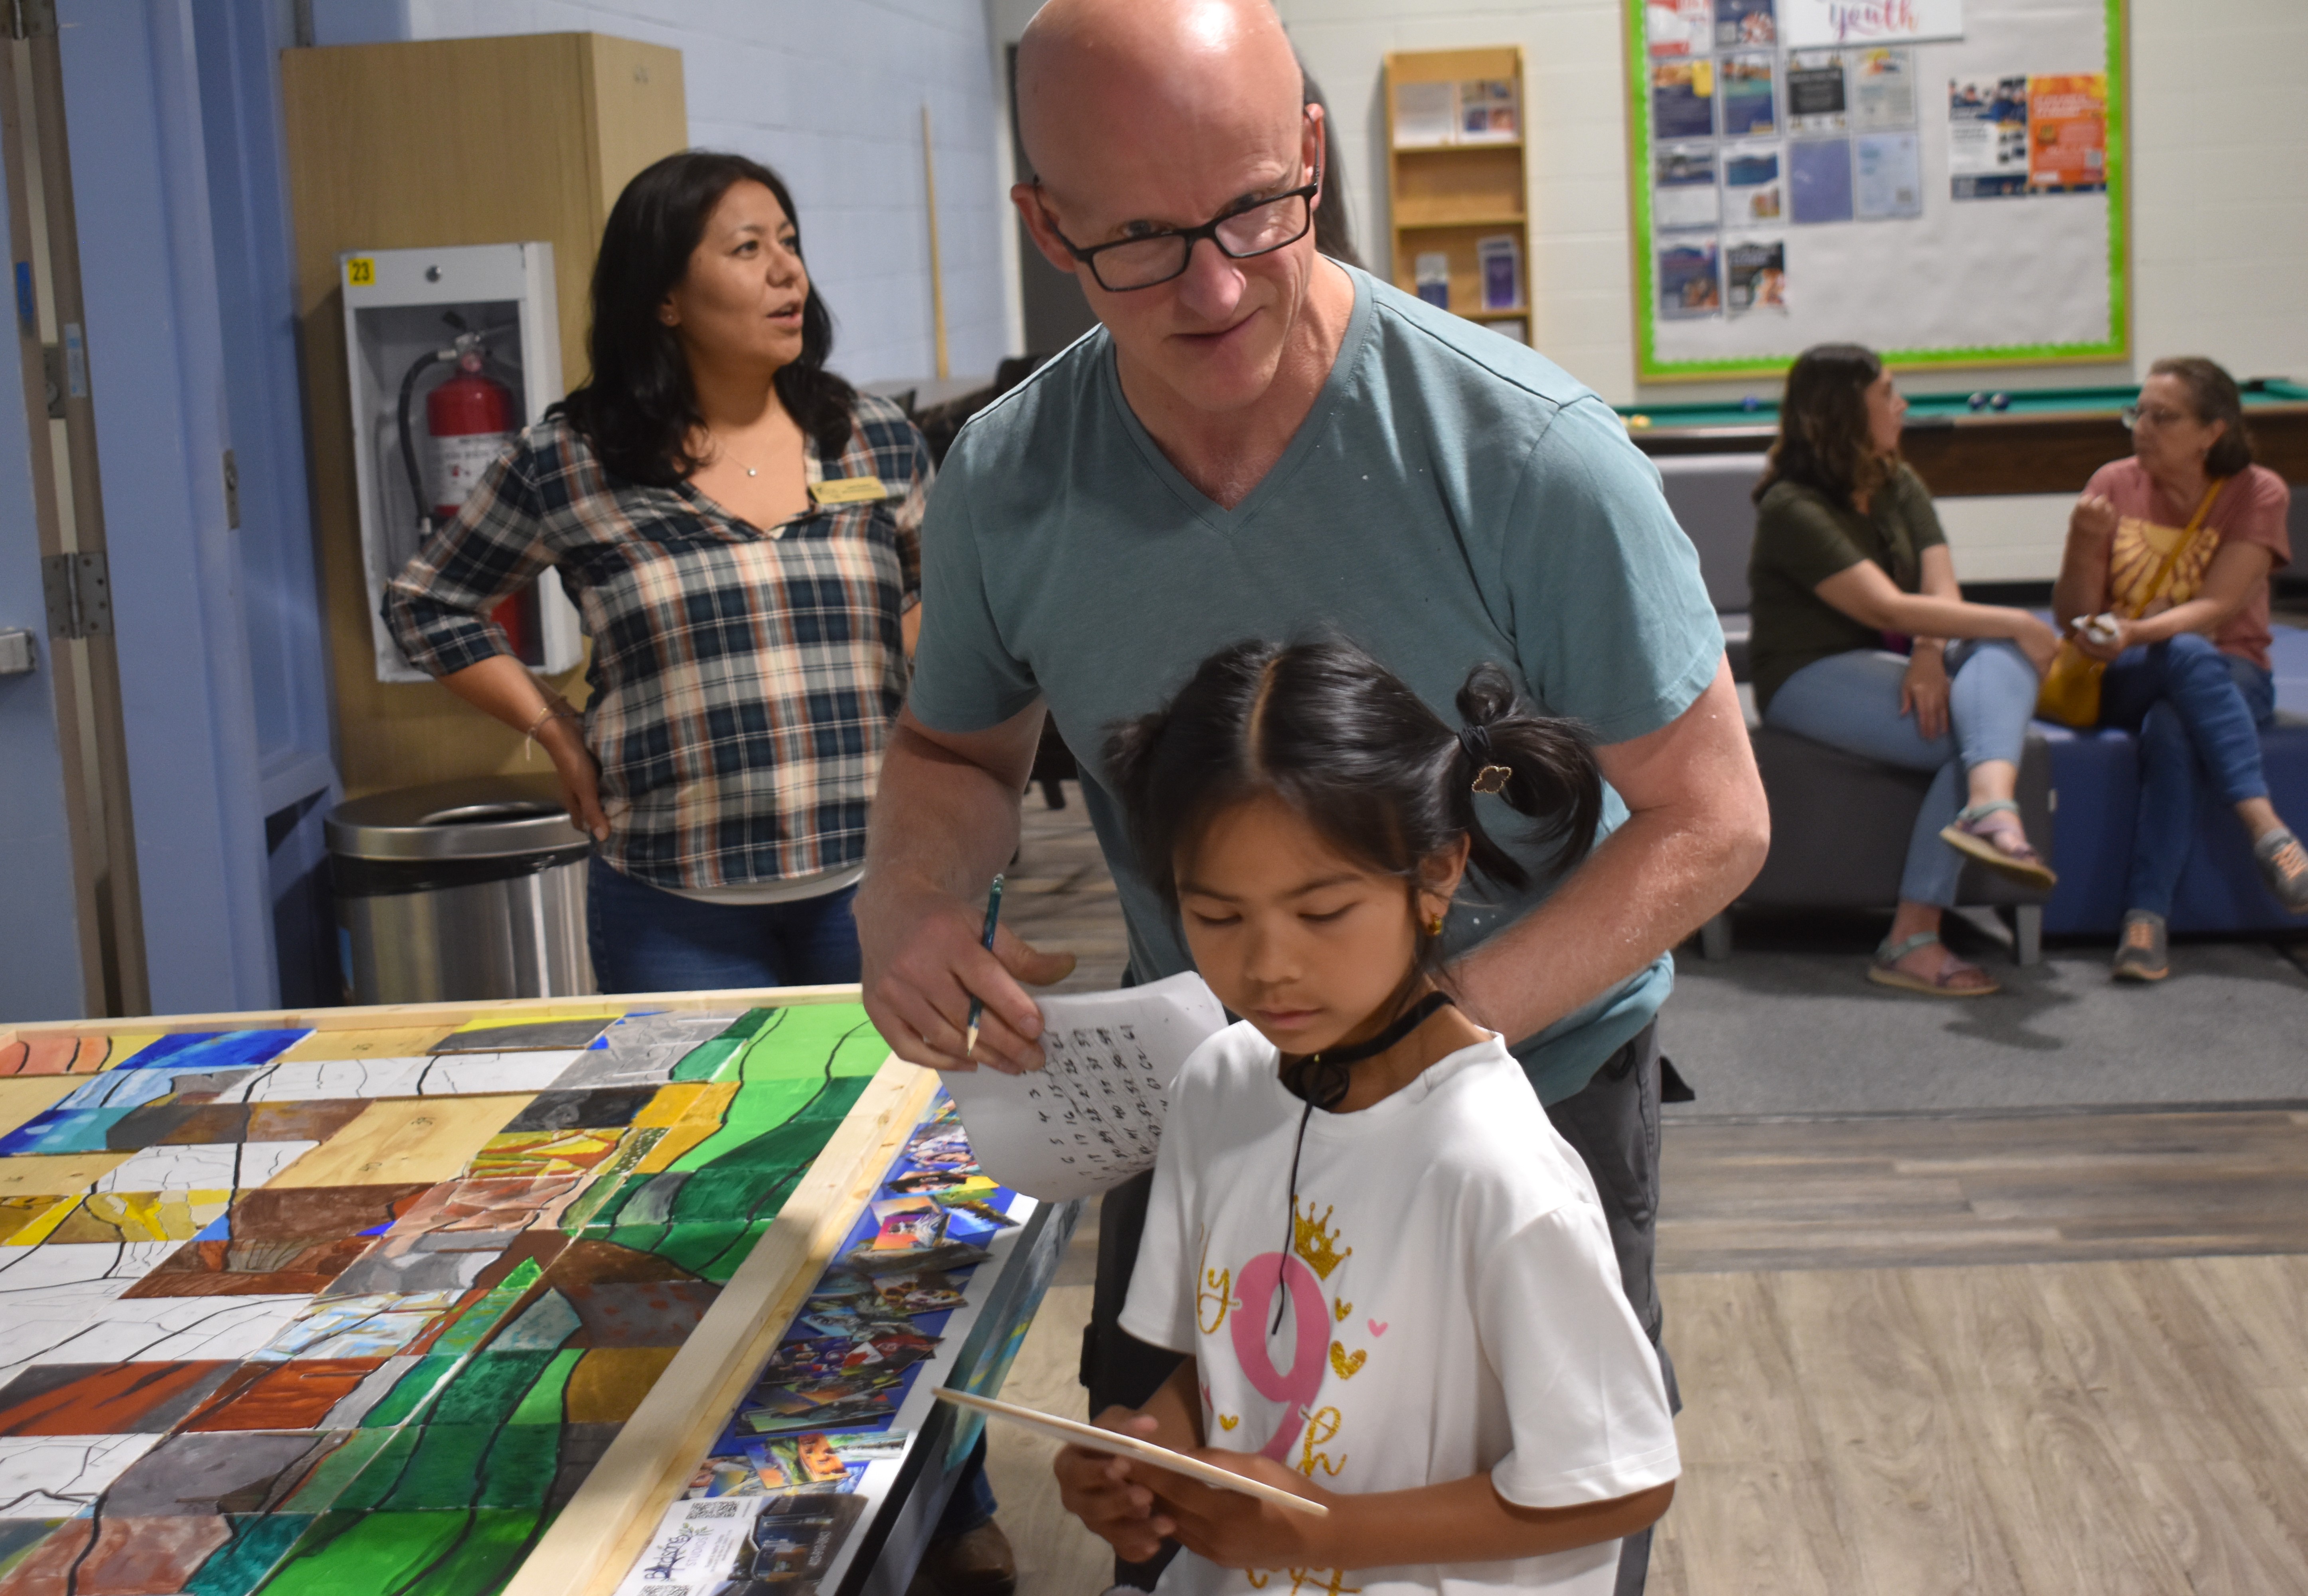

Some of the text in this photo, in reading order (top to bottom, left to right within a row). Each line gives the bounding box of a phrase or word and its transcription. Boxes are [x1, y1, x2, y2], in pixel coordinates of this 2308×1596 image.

[352, 262, 370, 281] 23
[1120, 1024, 1135, 1039] 61
[1136, 1045, 1153, 1070] 62
[1047, 1084, 1063, 1097] 15
[1147, 1078, 1161, 1090] 63
[1030, 1089, 1041, 1098] 3
[1112, 1105, 1126, 1118] 40
[1136, 1100, 1152, 1116] 52
[1039, 1111, 1050, 1122] 4
[1064, 1111, 1077, 1124] 16
[1087, 1108, 1102, 1122] 28
[1074, 1134, 1089, 1145] 17
[686, 1536, 709, 1566] STUDIOS
